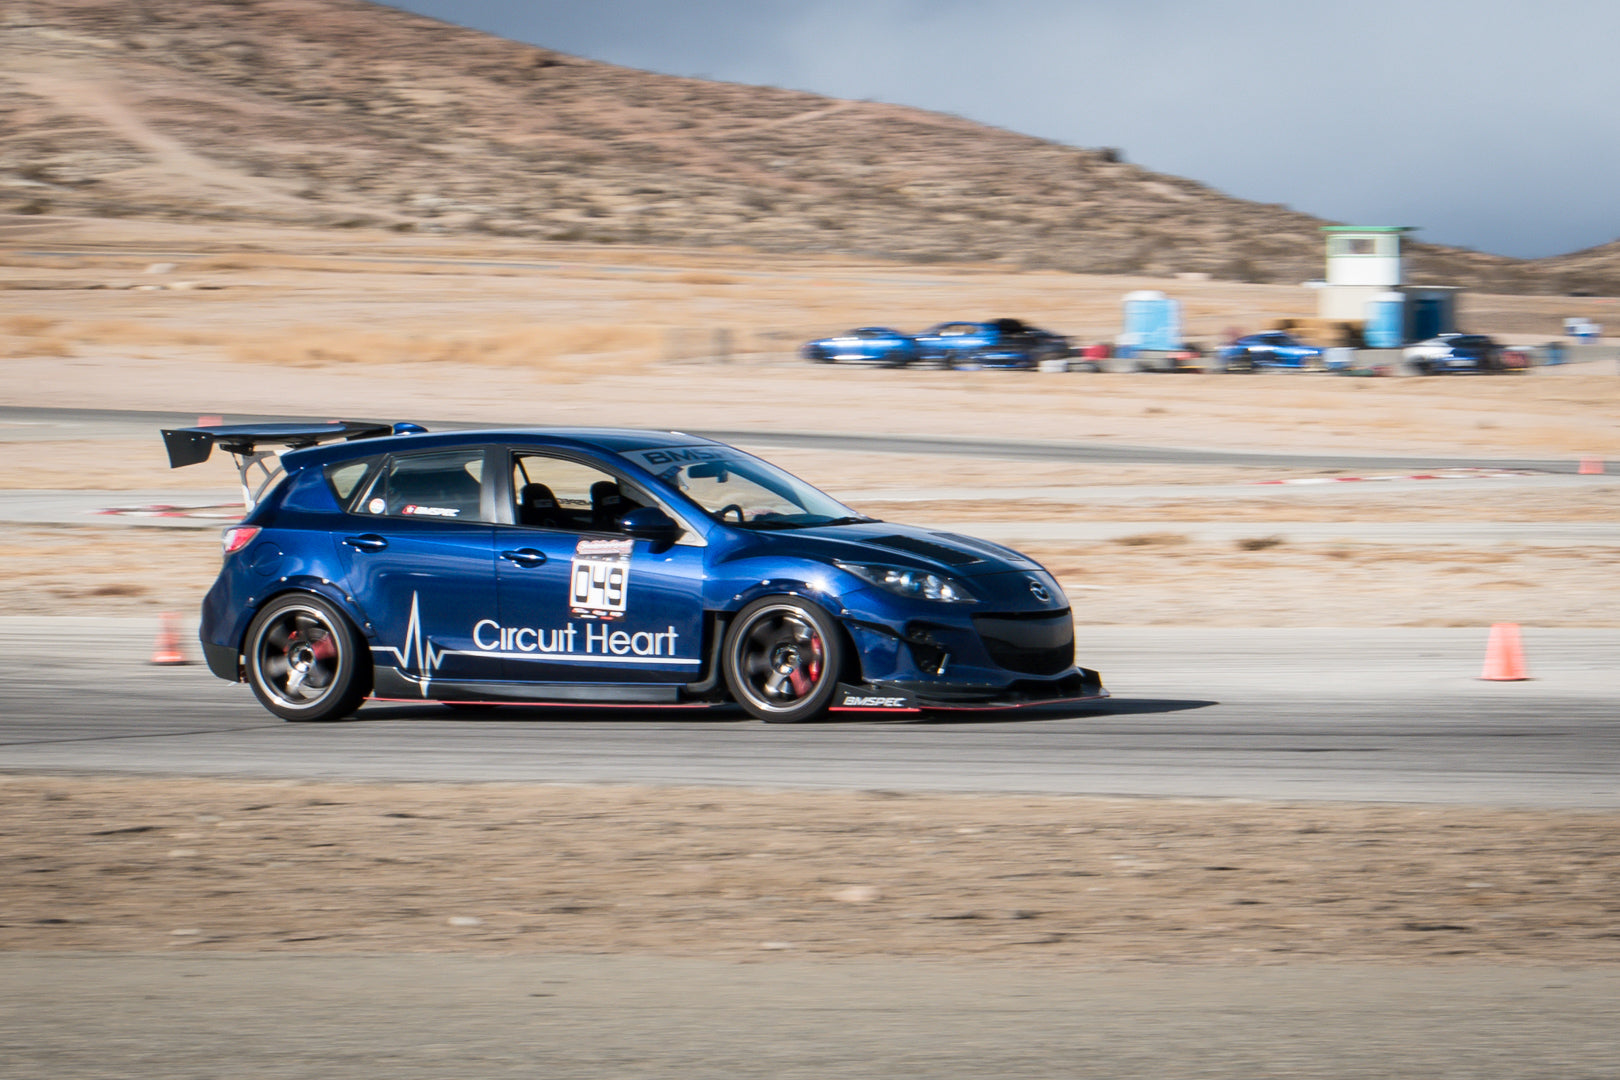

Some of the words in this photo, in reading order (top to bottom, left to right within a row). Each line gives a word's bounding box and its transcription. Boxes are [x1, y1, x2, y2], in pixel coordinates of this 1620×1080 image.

[641, 448, 736, 465] BMS
[472, 619, 578, 653] Circuit
[586, 623, 679, 656] Heart
[842, 696, 907, 707] BMSPEC
